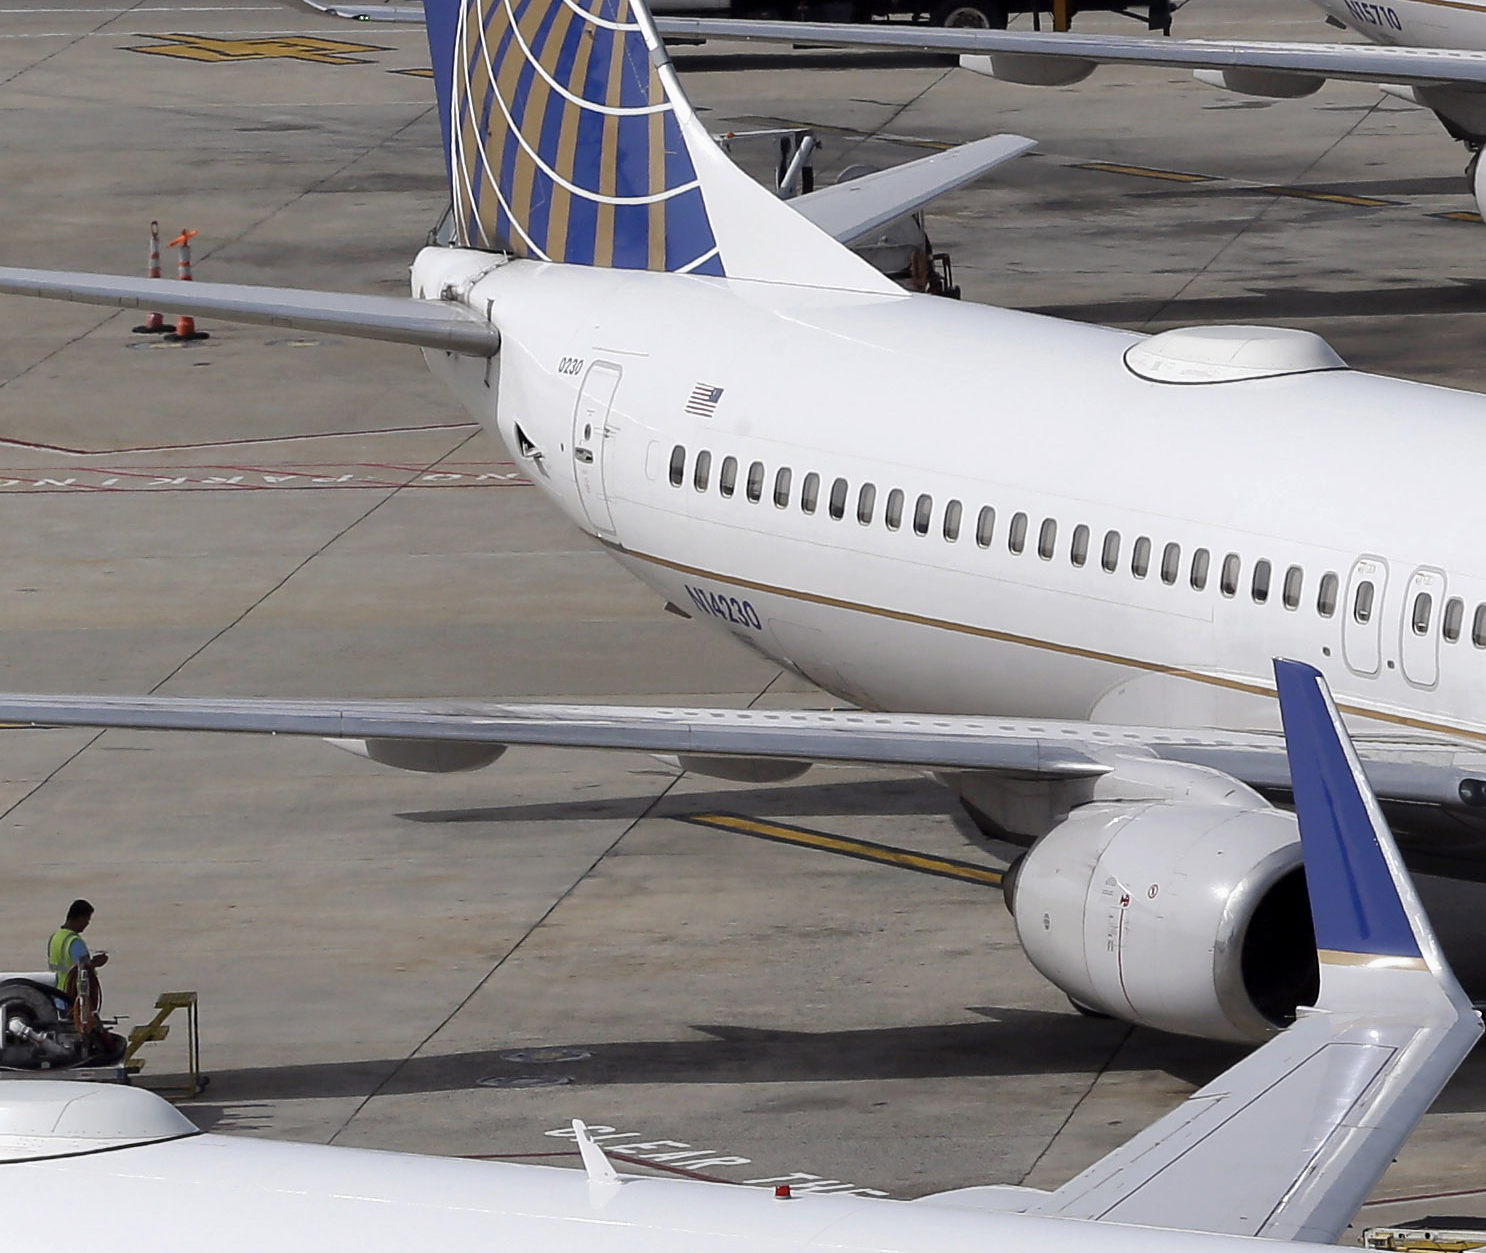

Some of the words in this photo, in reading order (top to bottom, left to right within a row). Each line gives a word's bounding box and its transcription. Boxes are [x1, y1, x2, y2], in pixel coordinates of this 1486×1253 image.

[558, 357, 584, 376] 0230
[684, 584, 763, 631] N14230
[544, 1124, 752, 1170] CLEAR
